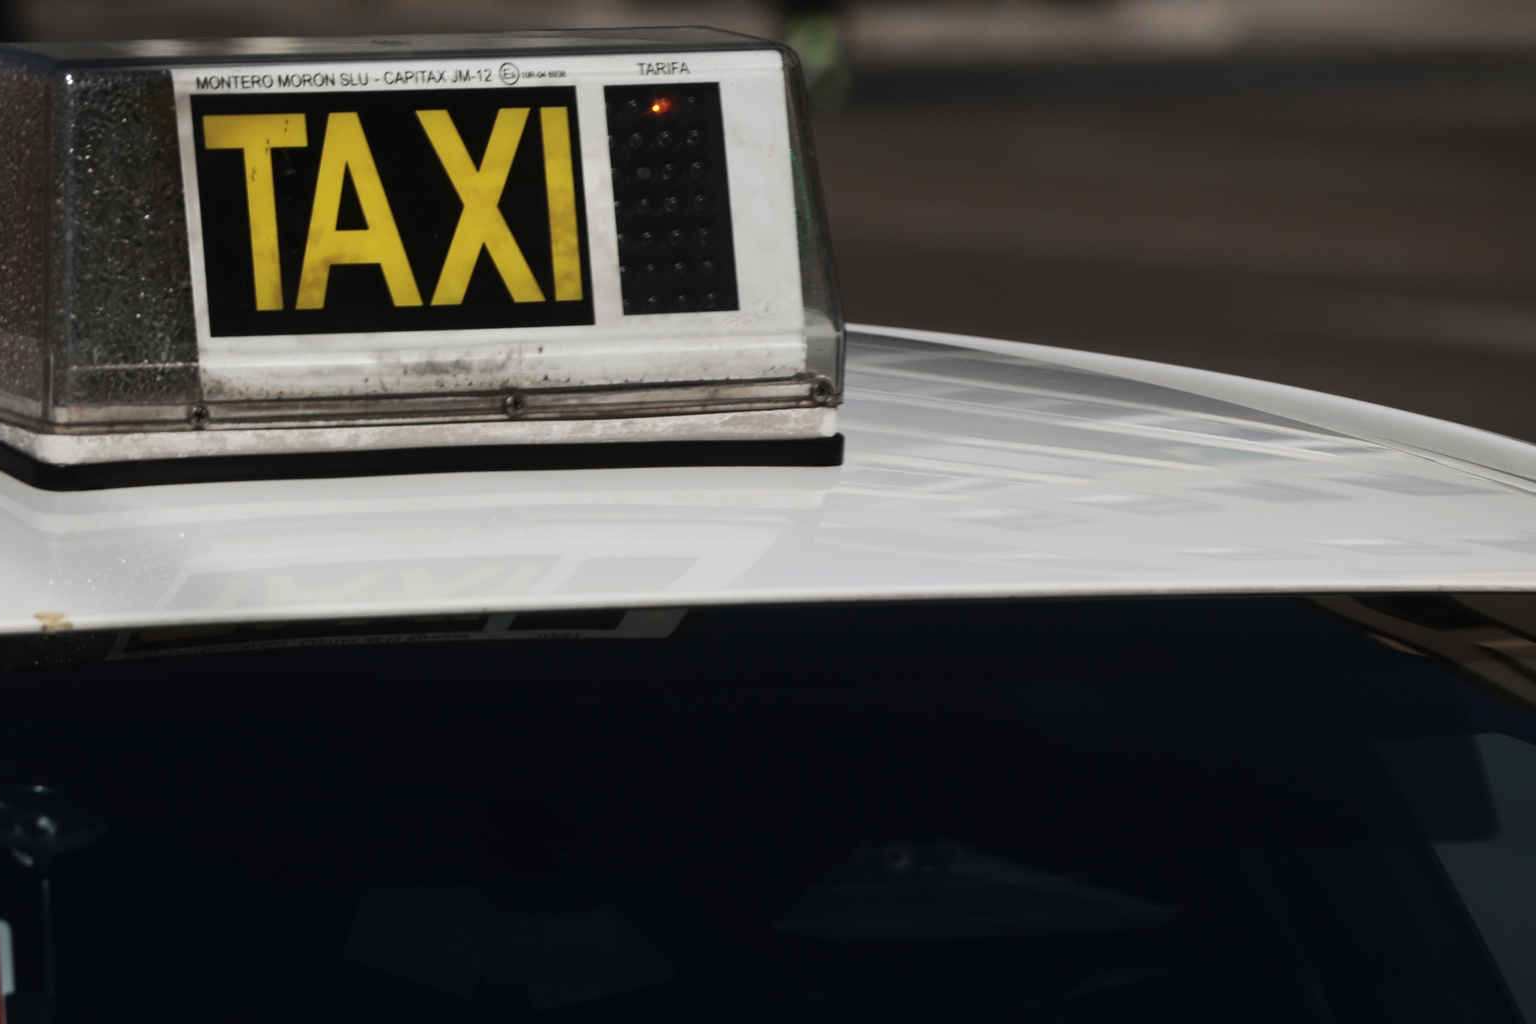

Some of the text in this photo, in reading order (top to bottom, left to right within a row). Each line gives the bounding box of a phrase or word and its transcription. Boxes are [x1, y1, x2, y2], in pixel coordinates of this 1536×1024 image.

[195, 74, 274, 90] MONTERO
[277, 71, 336, 88] MORÓN
[340, 72, 369, 87] SLU
[383, 69, 447, 85] CAPITAX
[451, 69, 493, 84] JM-12
[636, 62, 691, 76] TARIFA
[202, 106, 584, 312] TAXI
